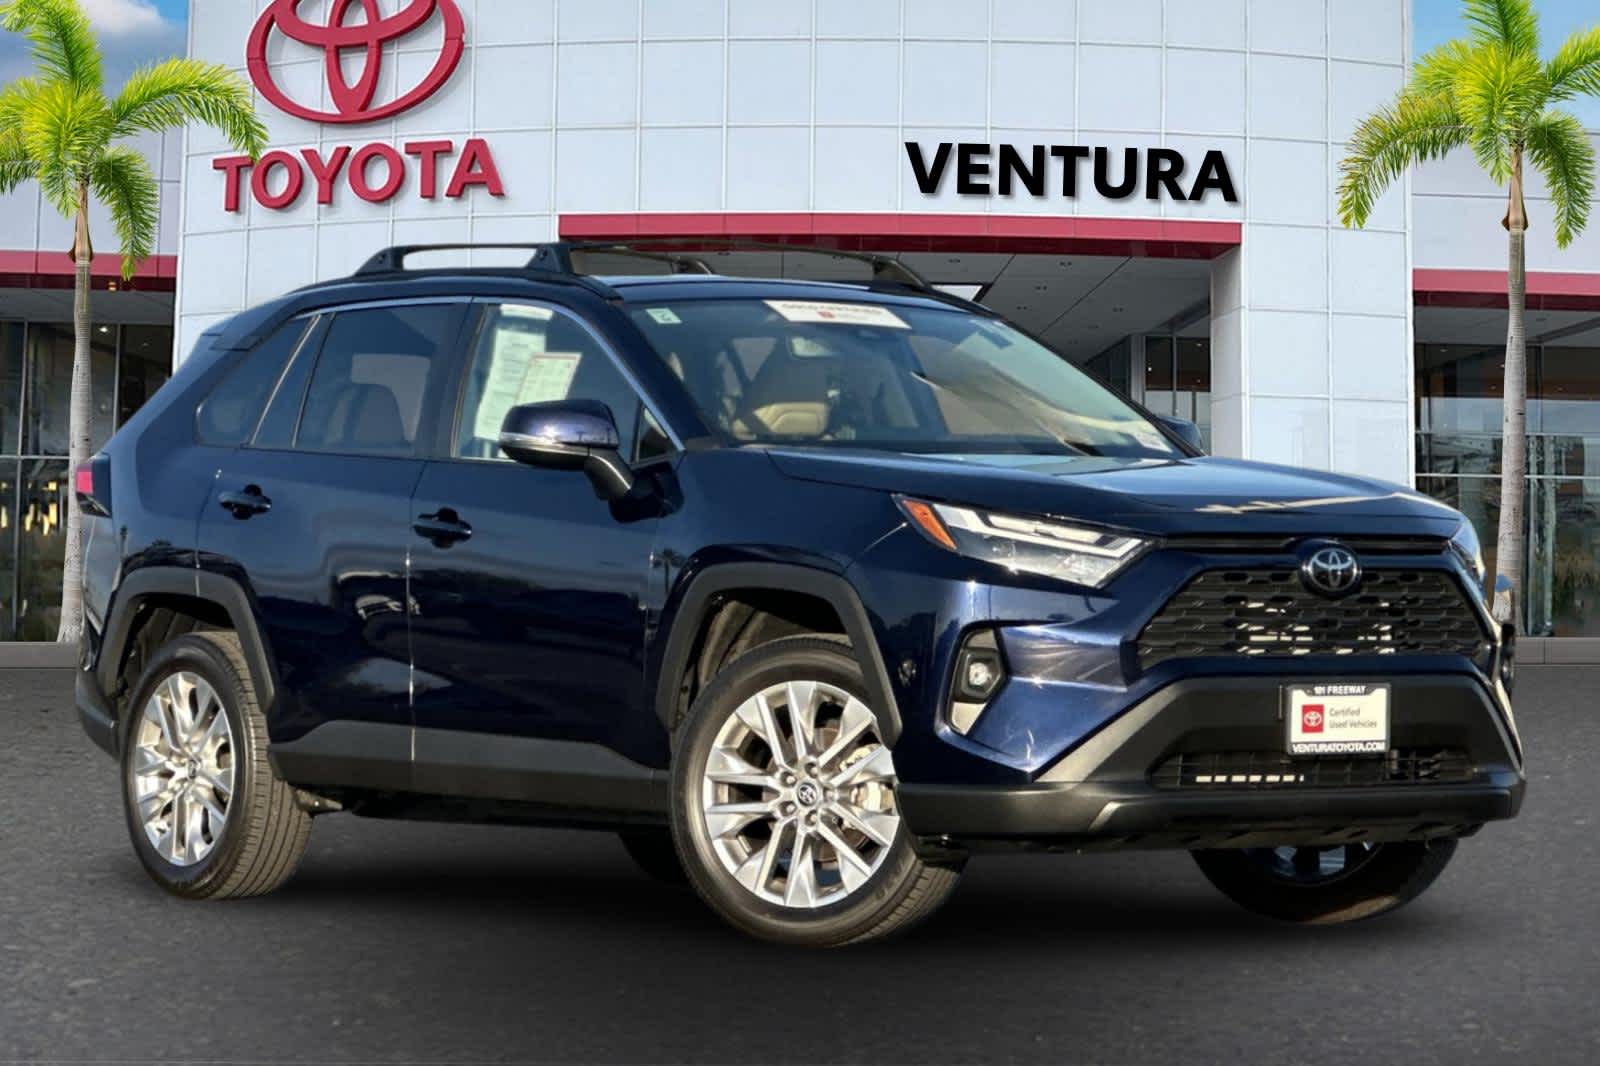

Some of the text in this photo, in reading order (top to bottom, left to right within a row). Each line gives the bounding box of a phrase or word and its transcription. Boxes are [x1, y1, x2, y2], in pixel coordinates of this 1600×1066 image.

[212, 138, 505, 212] TOYOTA
[904, 141, 1239, 203] VENTURA
[1327, 685, 1366, 695] FREEWAY
[1329, 707, 1361, 718] Certified
[1329, 719, 1378, 729] Used Vehicles
[1292, 742, 1386, 754] VENTURATOYOTA.COM
